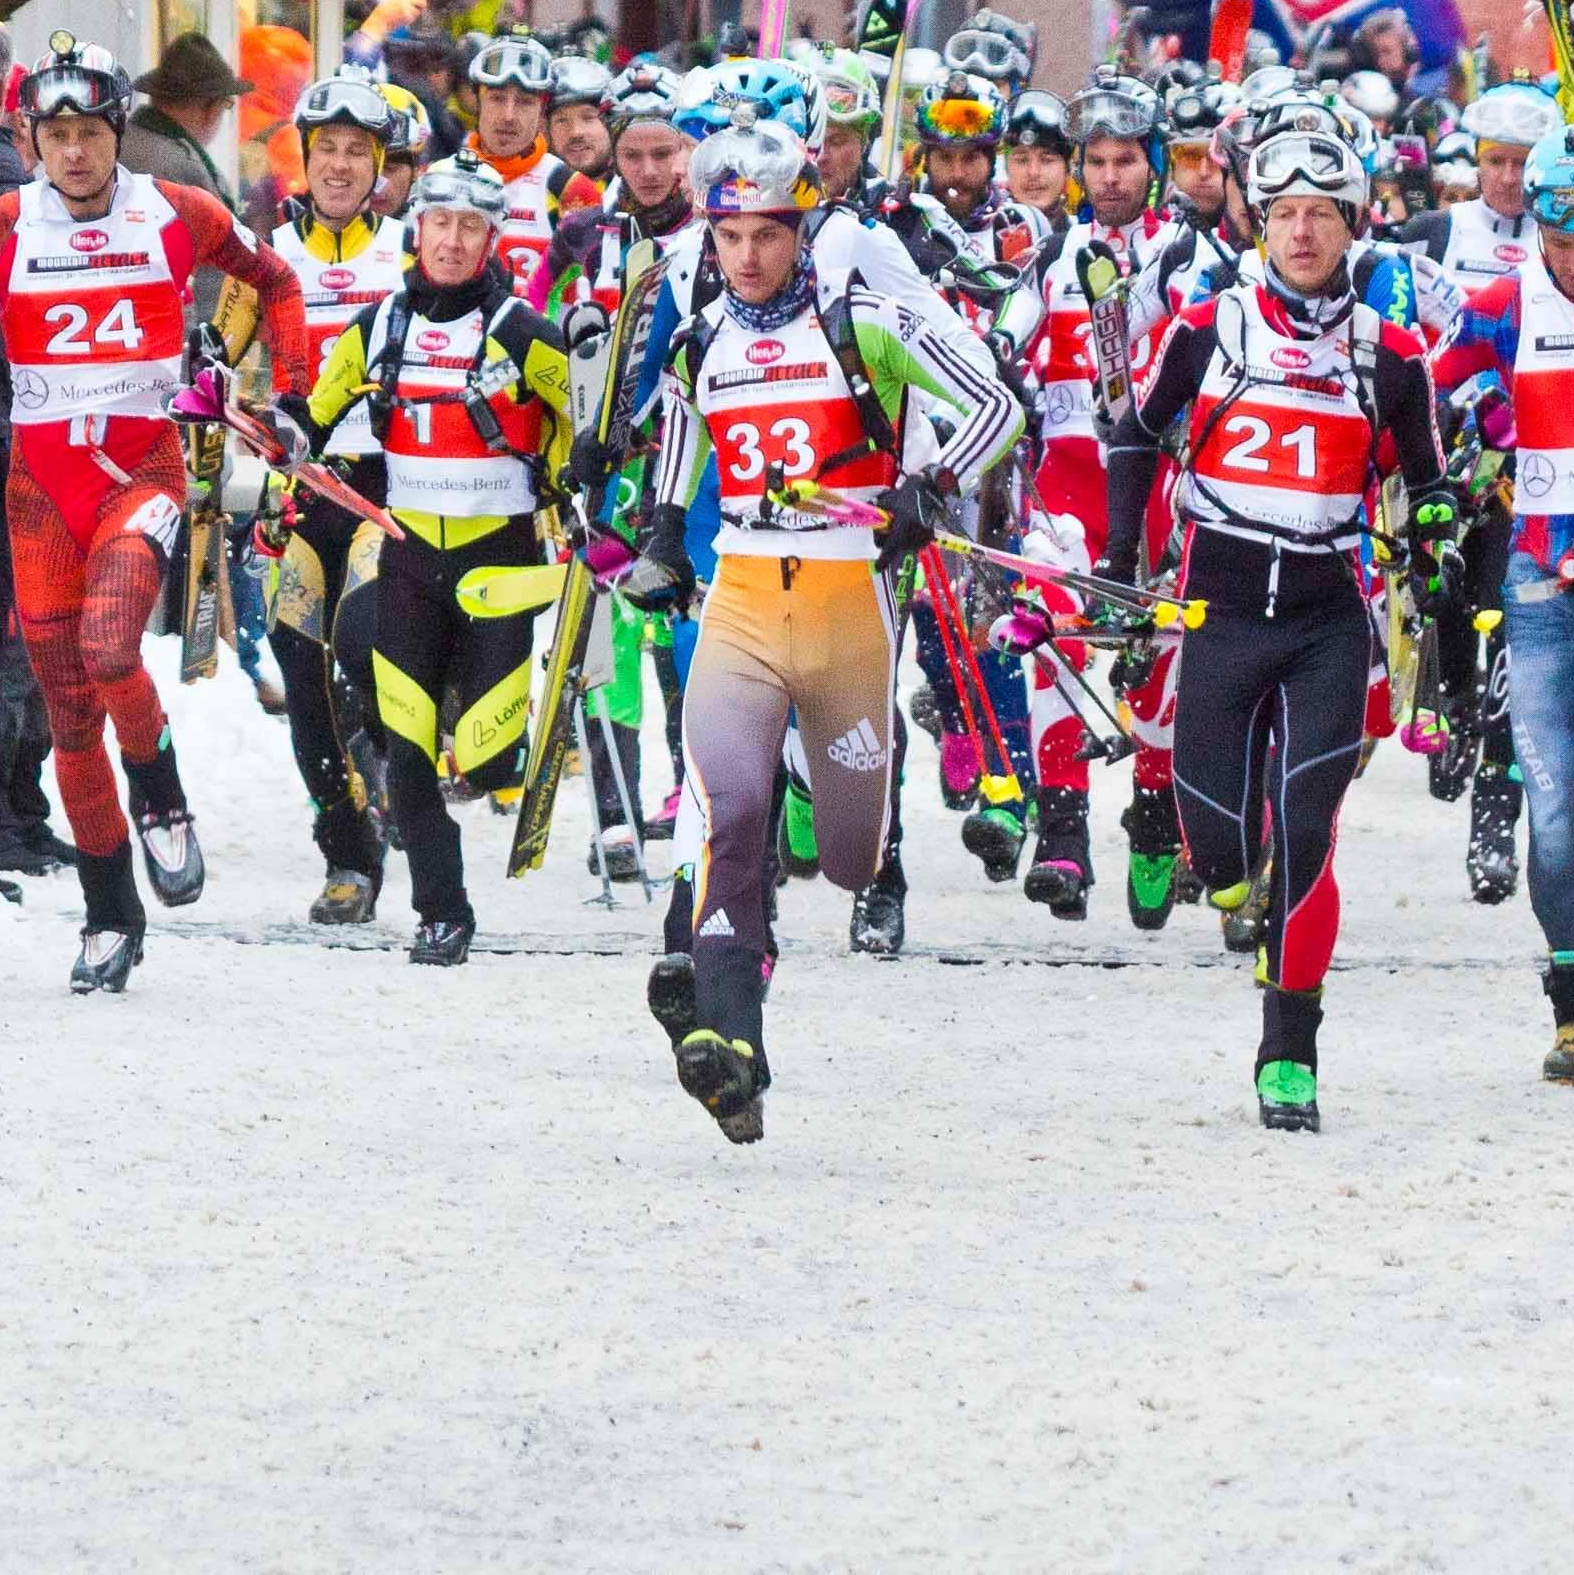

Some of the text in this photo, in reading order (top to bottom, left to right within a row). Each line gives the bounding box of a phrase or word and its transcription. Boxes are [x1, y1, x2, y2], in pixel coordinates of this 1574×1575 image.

[71, 231, 107, 250] Hervis
[43, 297, 145, 356] 24
[747, 344, 784, 362] Hervis
[1274, 349, 1310, 367] Hervis
[58, 379, 188, 400] Mercedes-Ben
[725, 416, 816, 481] 33
[1221, 414, 1318, 479] 21
[397, 472, 512, 492] Mercedes-Benz
[827, 738, 888, 773] adidas
